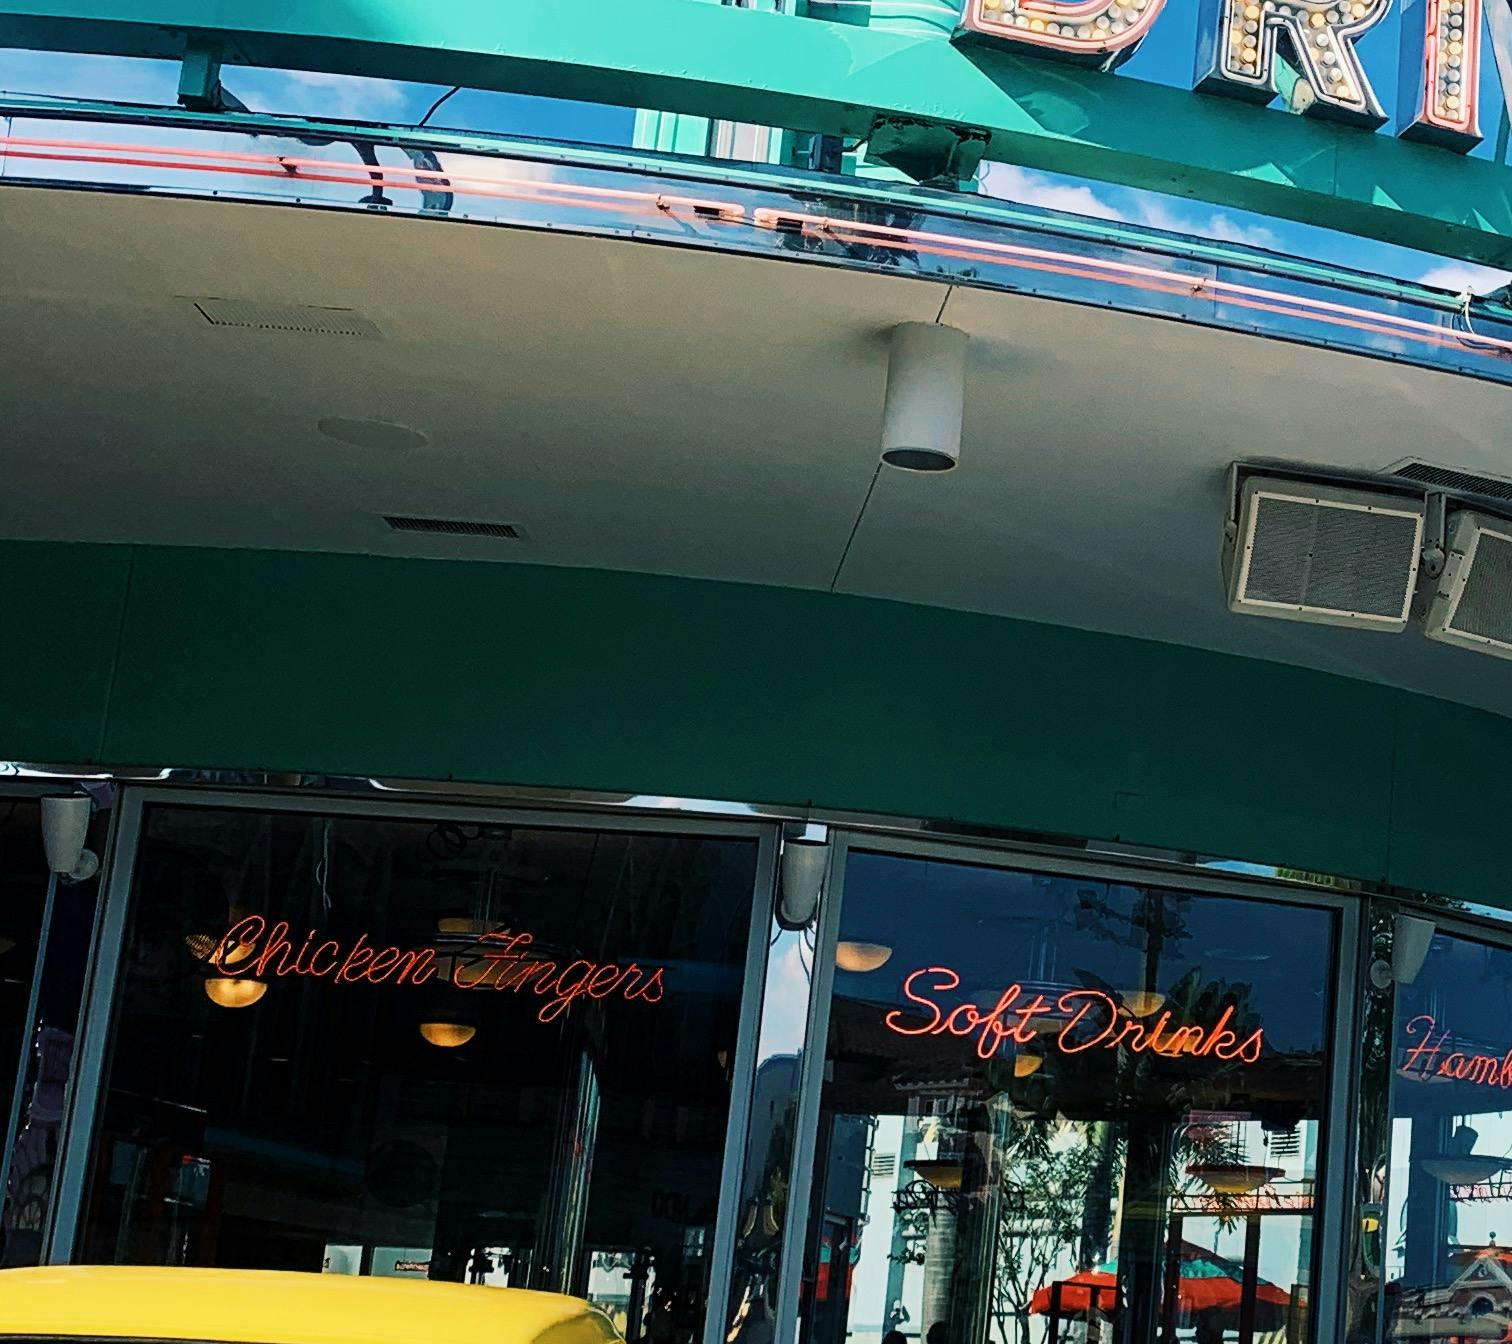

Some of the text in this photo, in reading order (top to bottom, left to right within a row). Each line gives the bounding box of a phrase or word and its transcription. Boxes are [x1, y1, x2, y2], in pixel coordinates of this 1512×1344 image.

[213, 914, 665, 1023] Chicken Fingers
[885, 966, 1265, 1064] Soft Drinks
